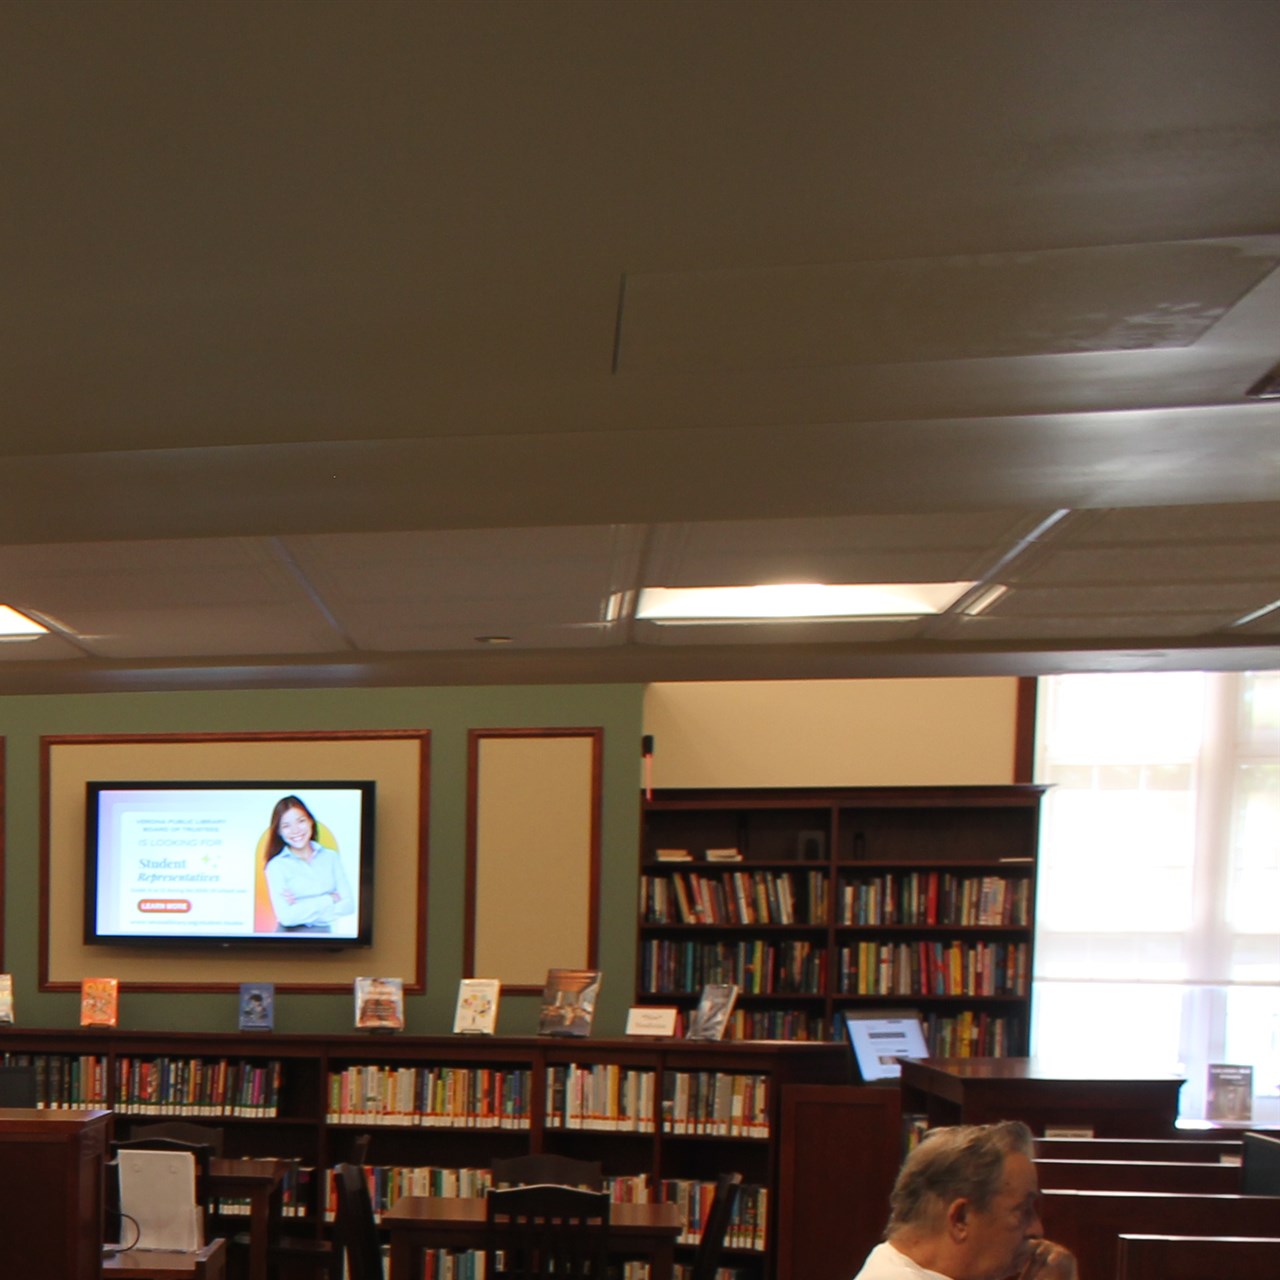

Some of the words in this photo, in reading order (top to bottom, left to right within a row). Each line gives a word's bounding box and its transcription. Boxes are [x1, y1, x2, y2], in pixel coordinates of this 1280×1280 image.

[150, 839, 198, 847] LOOKING
[138, 857, 187, 869] Student
[137, 872, 221, 884] Representatives
